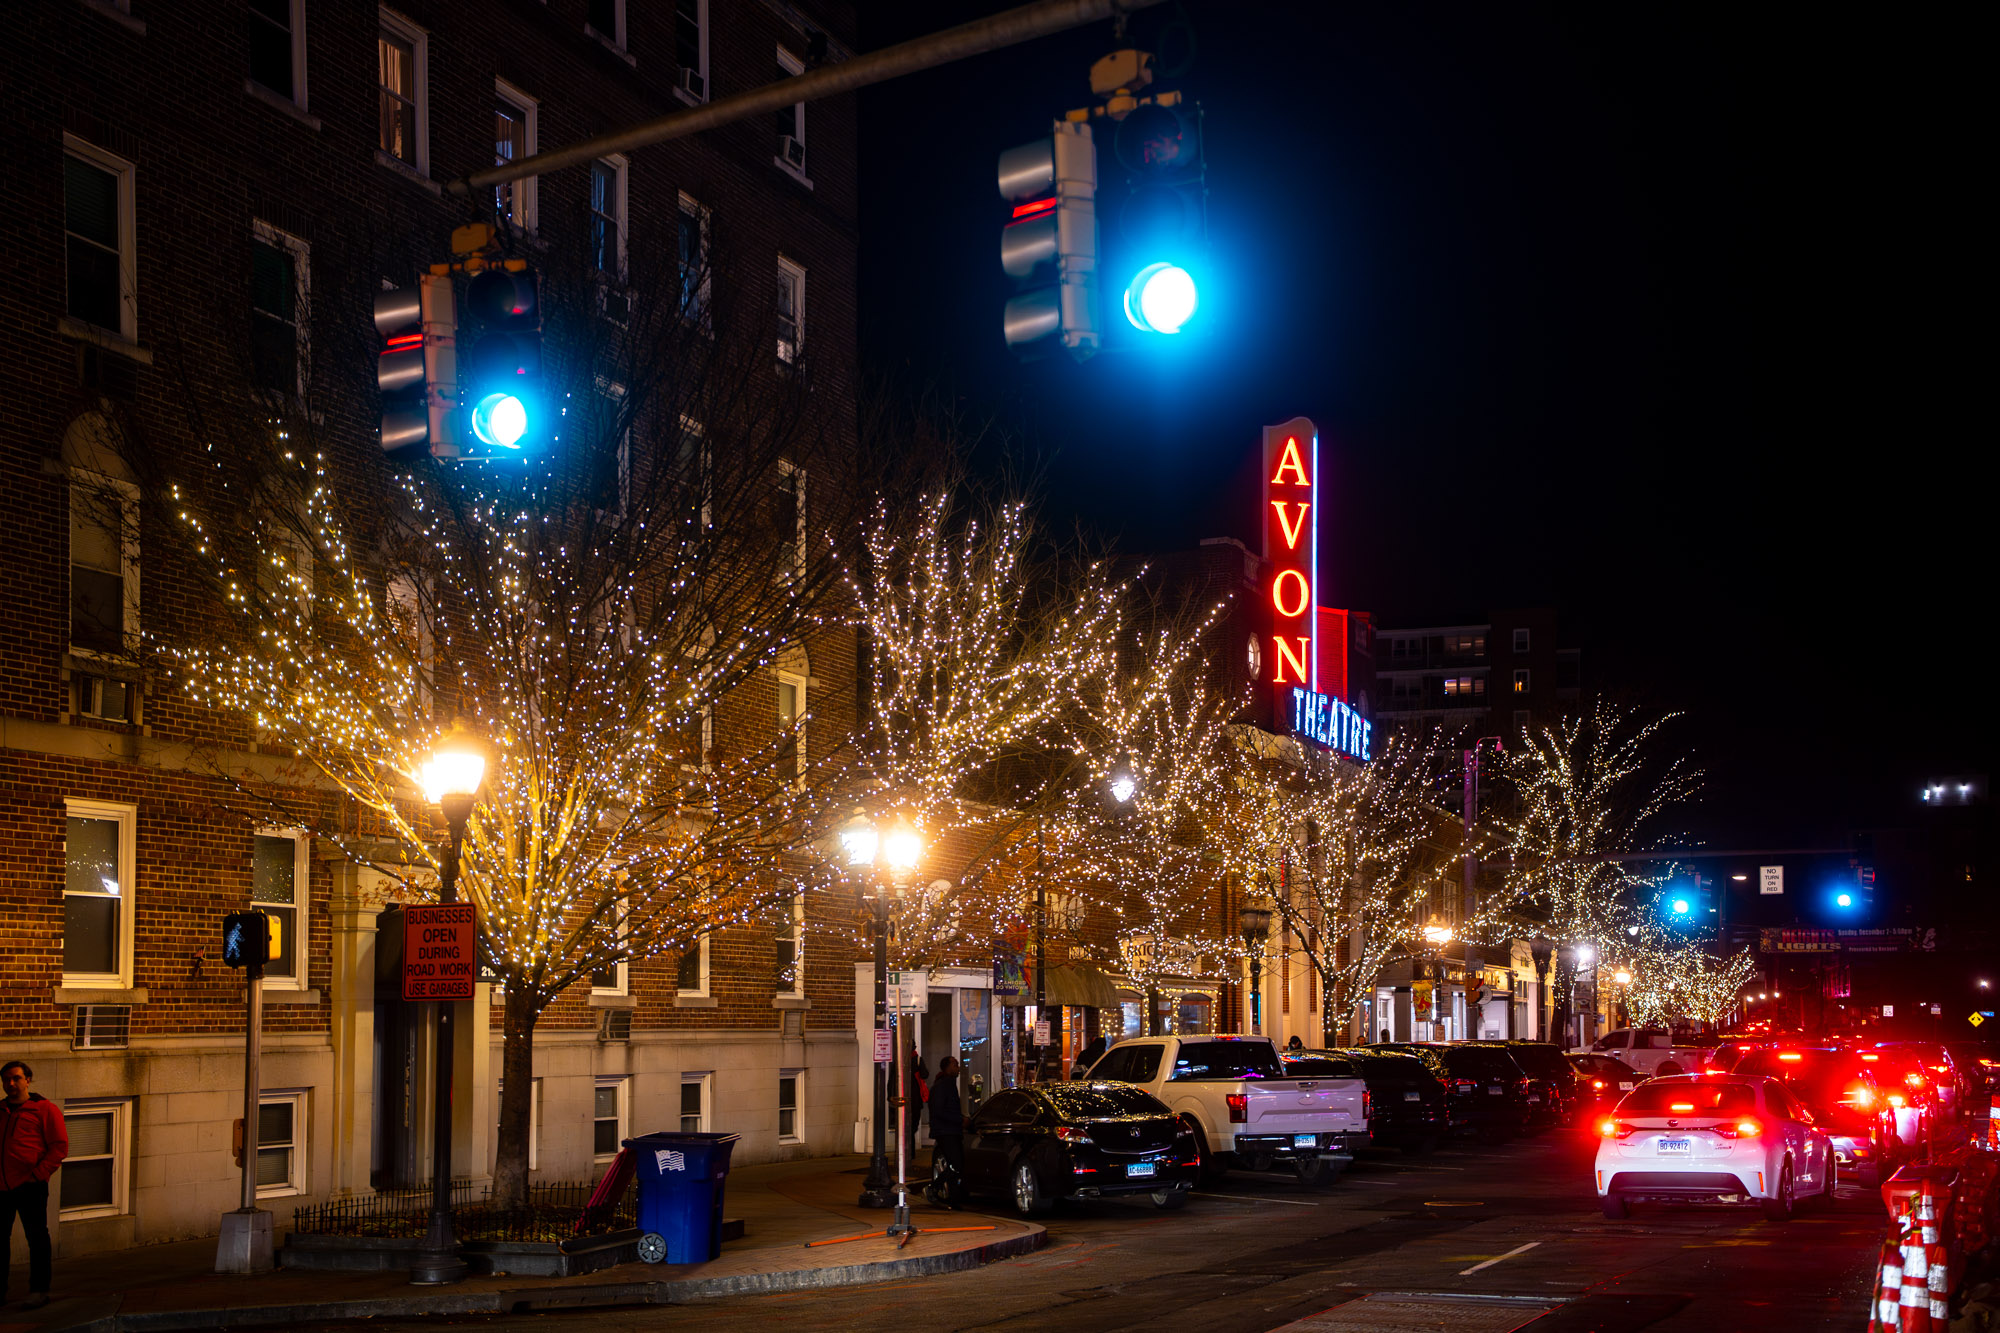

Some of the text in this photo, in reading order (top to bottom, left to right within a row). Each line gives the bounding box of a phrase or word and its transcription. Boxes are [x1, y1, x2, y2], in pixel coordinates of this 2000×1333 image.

[1271, 436, 1311, 684] AVON
[1293, 686, 1371, 761] THEATRE
[408, 909, 472, 924] BUSINESSES
[423, 928, 457, 943] OPEN
[1781, 928, 1835, 943] HEIGHTS
[1858, 928, 1885, 936] December
[418, 946, 460, 959] DURING
[1777, 942, 1841, 950] LIGHTS
[407, 962, 471, 976] ROAD WORK
[889, 973, 896, 984] 1
[408, 982, 469, 995] USE GARAGES
